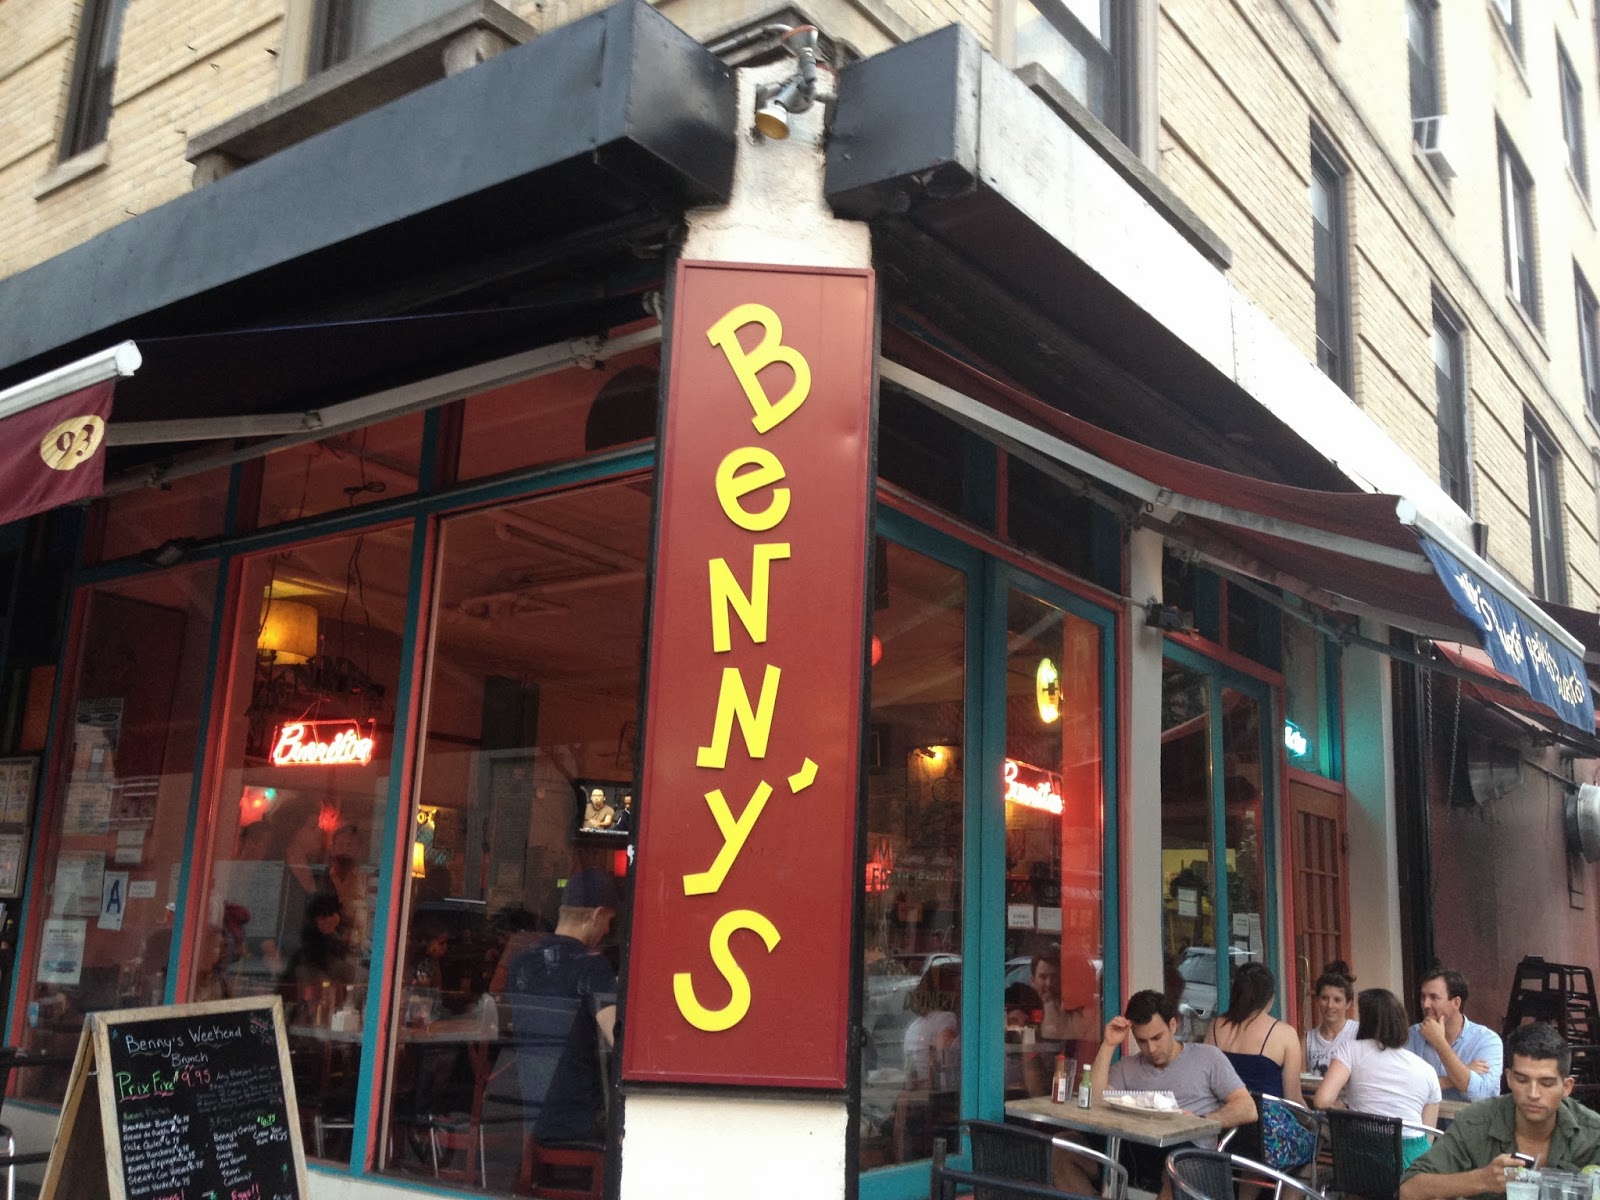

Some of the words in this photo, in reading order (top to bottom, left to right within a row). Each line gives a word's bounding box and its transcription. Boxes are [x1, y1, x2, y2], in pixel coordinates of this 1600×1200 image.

[57, 424, 95, 463] 93
[106, 880, 121, 914] A
[125, 1034, 184, 1058] Benny's
[171, 1053, 208, 1067] Brunch
[115, 1071, 150, 1097] Prix
[152, 1070, 174, 1091] Fixe
